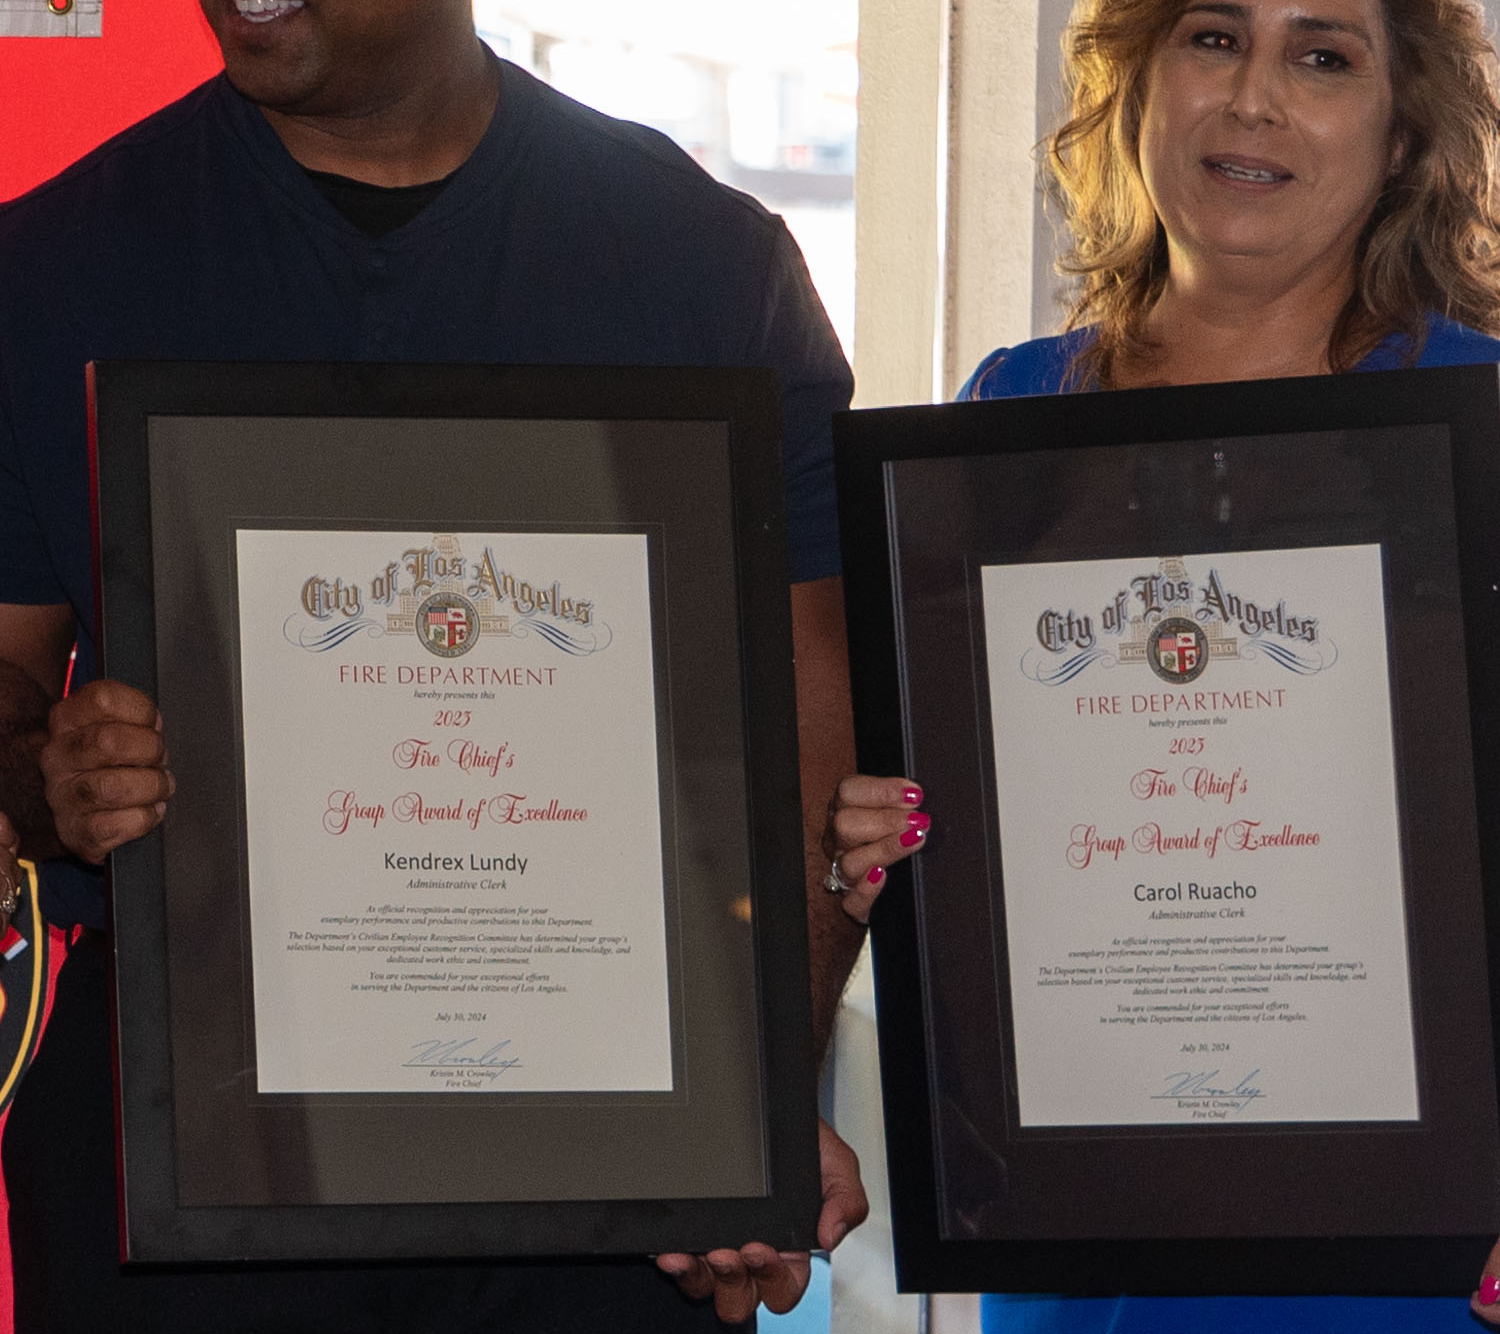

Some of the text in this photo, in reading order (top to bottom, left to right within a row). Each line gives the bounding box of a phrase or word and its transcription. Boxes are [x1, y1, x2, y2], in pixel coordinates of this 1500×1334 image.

[301, 575, 362, 620] City
[371, 562, 401, 605] of
[402, 547, 467, 586] Los
[467, 547, 594, 625] Angeles
[1036, 607, 1094, 652] City
[1101, 590, 1129, 635] of
[1130, 574, 1192, 614] Los
[1196, 568, 1320, 643] Angeles
[339, 665, 558, 686] FIRE DEPARTMENT
[413, 689, 496, 701] hereby presents this
[1075, 688, 1287, 716] FIRE DEPARTMENT
[433, 710, 472, 727] 2023
[392, 738, 514, 777] Fire Chief's
[1168, 737, 1205, 755] 2023
[1130, 767, 1248, 804] Fire Chief's
[322, 789, 588, 835] Group Award of Excellence
[1065, 819, 1321, 870] Group Award of Excellence
[384, 852, 528, 875] Kendrex Lundy
[406, 878, 507, 891] Administrative Clerk
[1133, 882, 1258, 902] Carol Ruacho
[1148, 908, 1246, 921] Administrative Clerk
